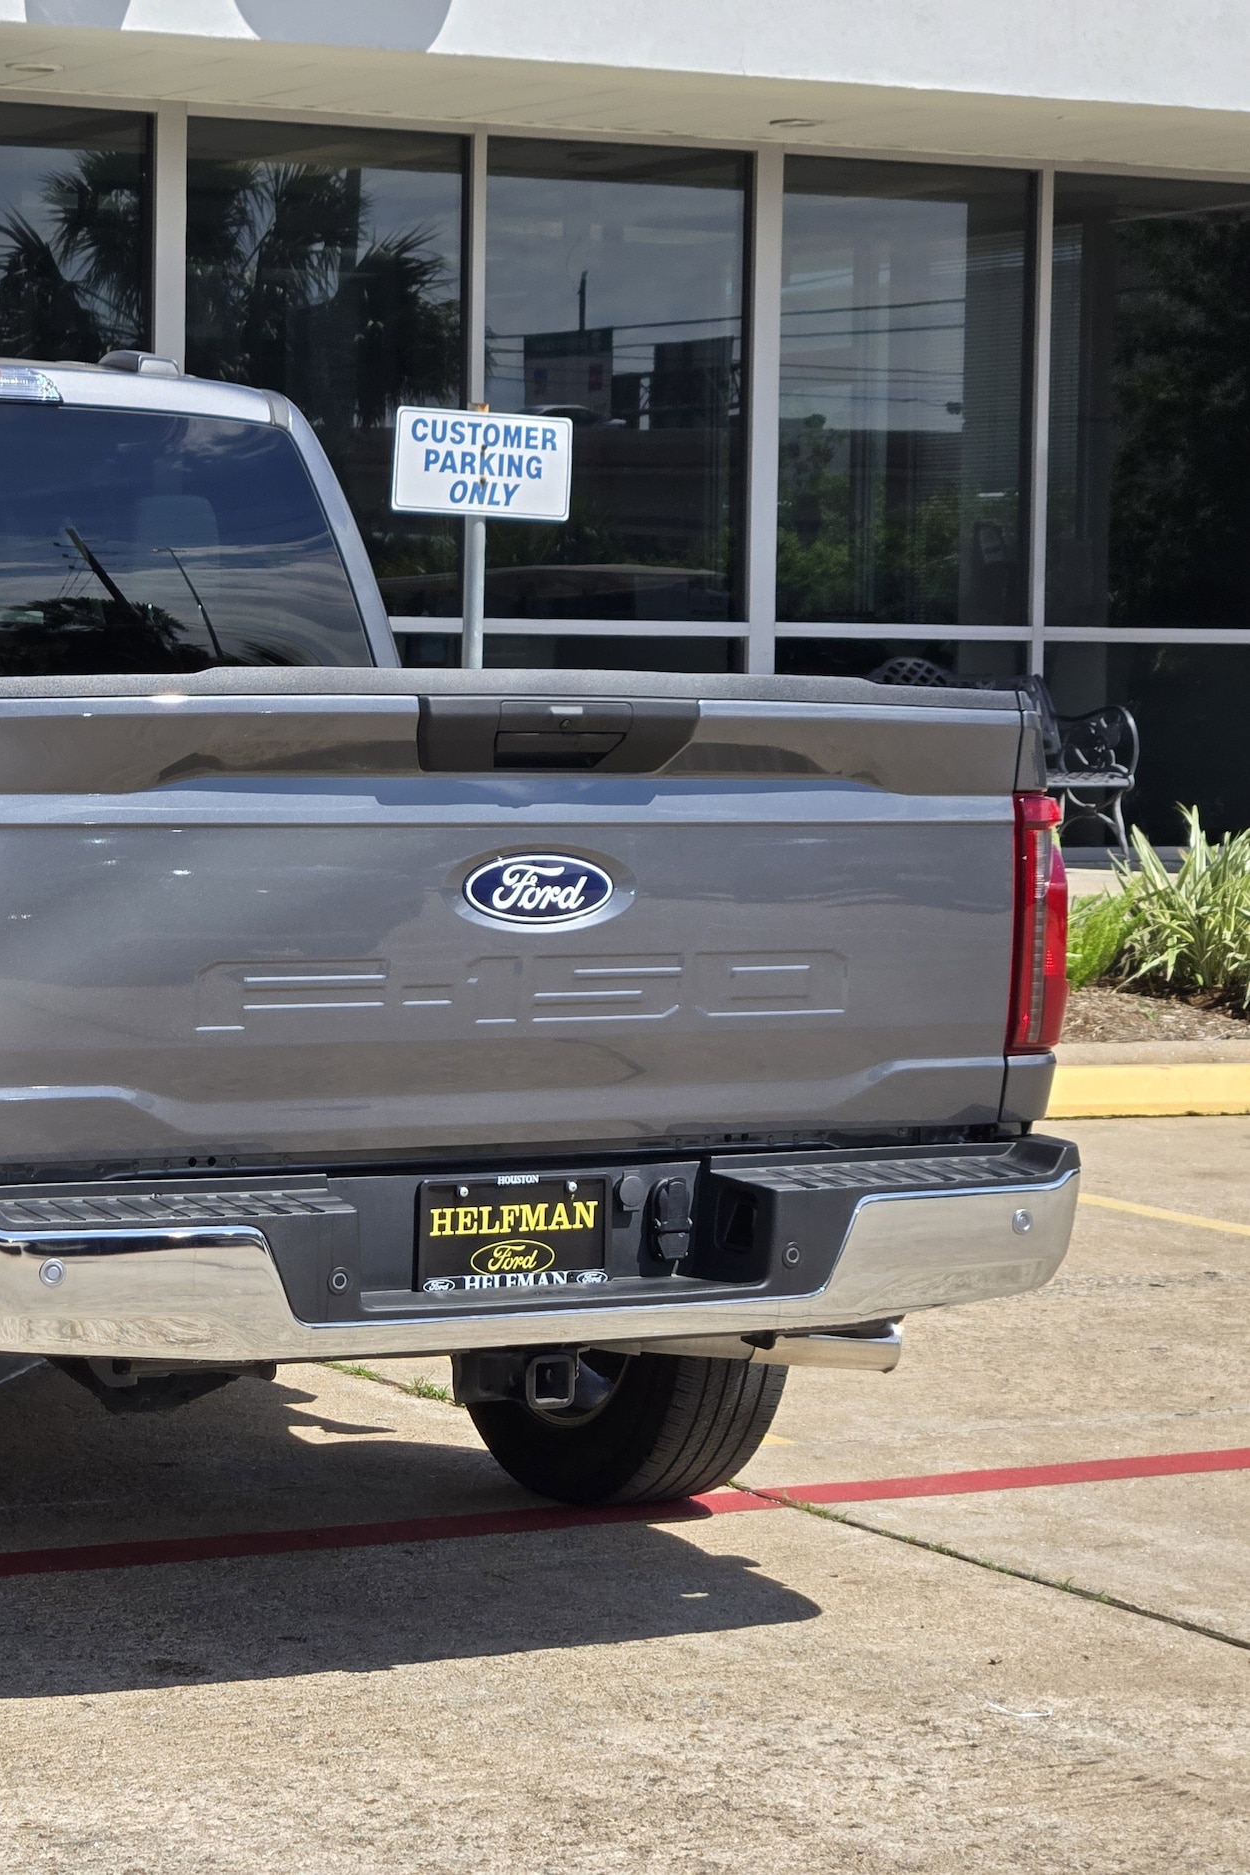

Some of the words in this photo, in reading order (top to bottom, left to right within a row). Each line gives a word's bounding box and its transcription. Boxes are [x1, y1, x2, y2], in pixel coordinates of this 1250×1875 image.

[411, 418, 557, 451] CUSTOMER
[424, 448, 542, 479] PARKING
[449, 480, 520, 507] ONLY
[492, 863, 587, 912] Ford
[195, 949, 847, 1031] F-150
[497, 1175, 540, 1186] HOUSTON
[429, 1200, 599, 1237] HELFMAN
[487, 1244, 539, 1272] Ford
